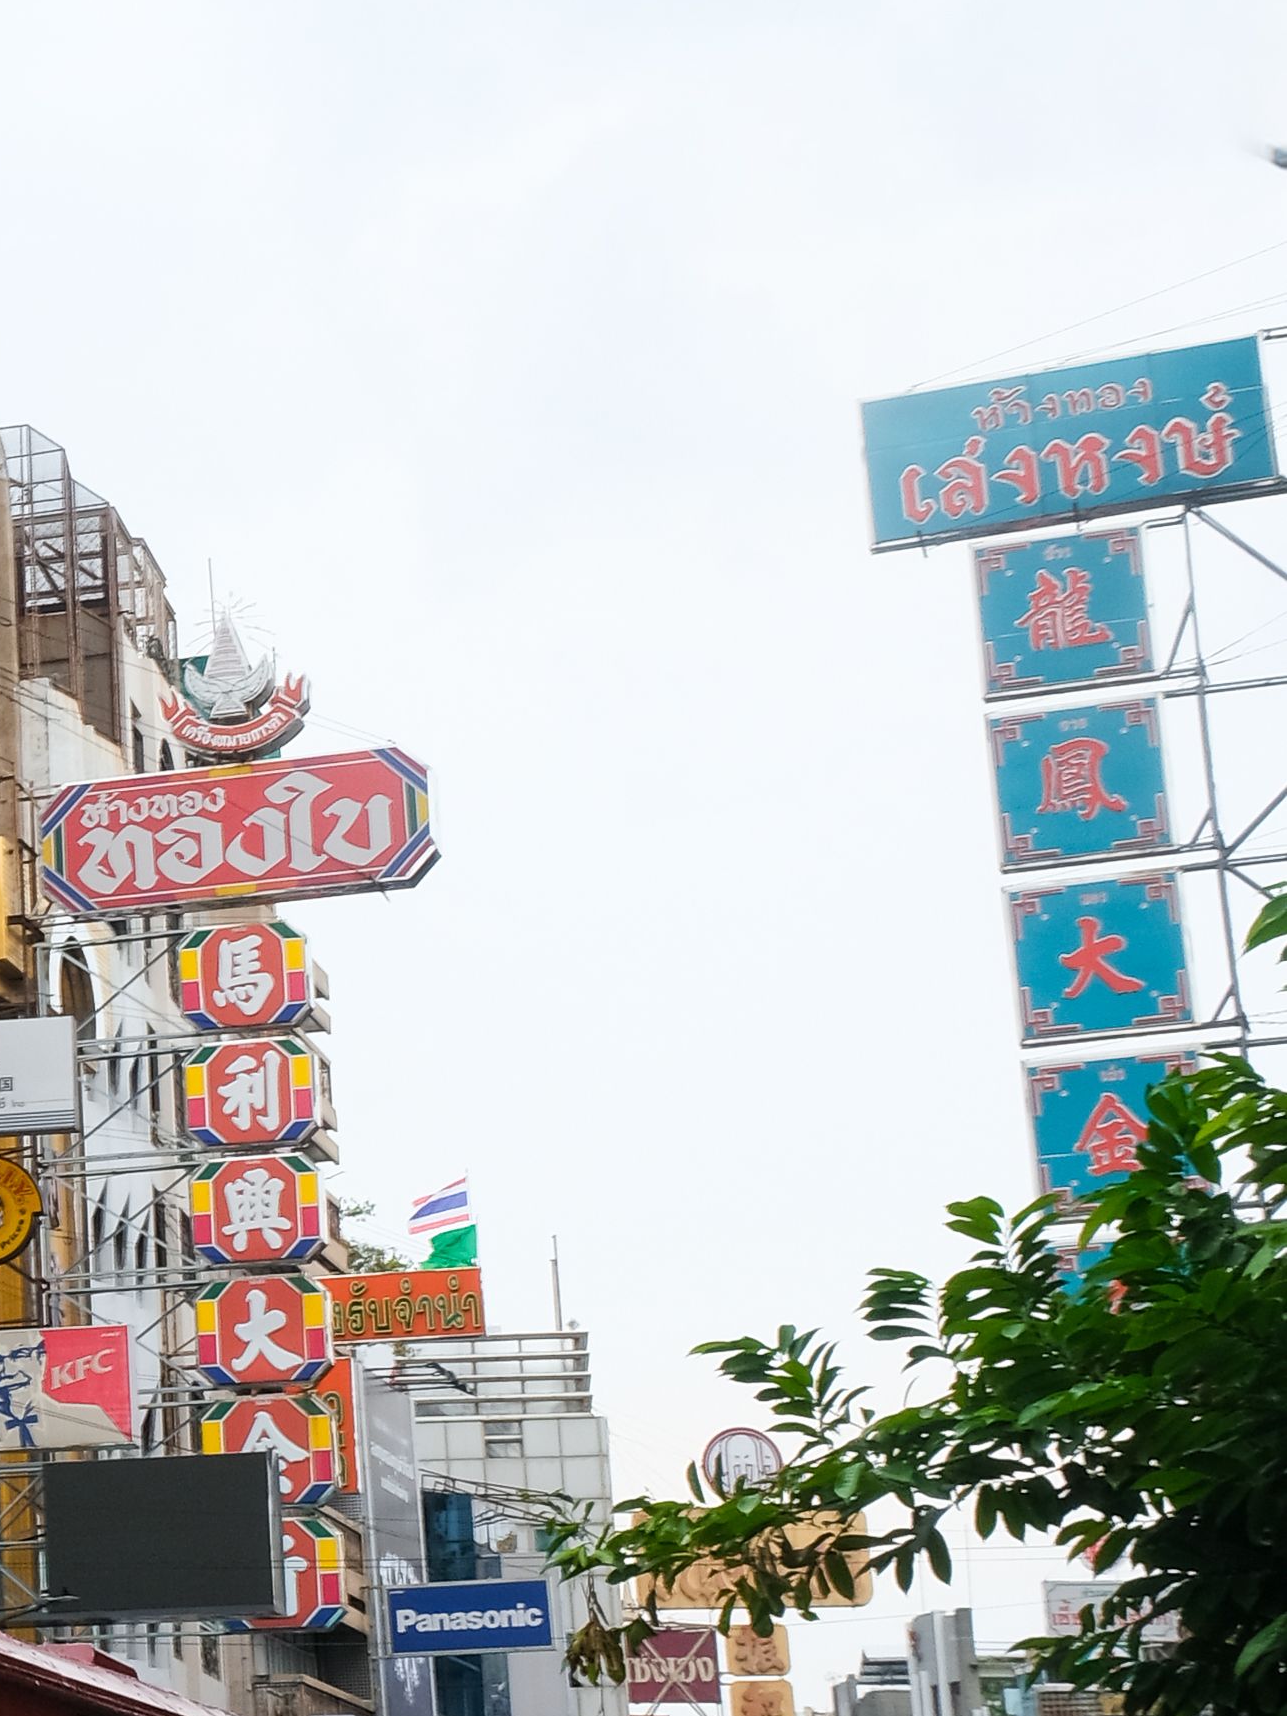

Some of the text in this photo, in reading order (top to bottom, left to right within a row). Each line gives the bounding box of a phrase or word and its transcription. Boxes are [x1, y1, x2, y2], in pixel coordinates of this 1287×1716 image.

[972, 376, 1153, 432] ห้างทอง
[900, 381, 1241, 524] เล่งหงษ์
[81, 786, 227, 827] ห้างทอง
[76, 772, 394, 894] ทองใบ
[50, 1347, 115, 1393] KFC
[396, 1601, 544, 1636] Panasonic
